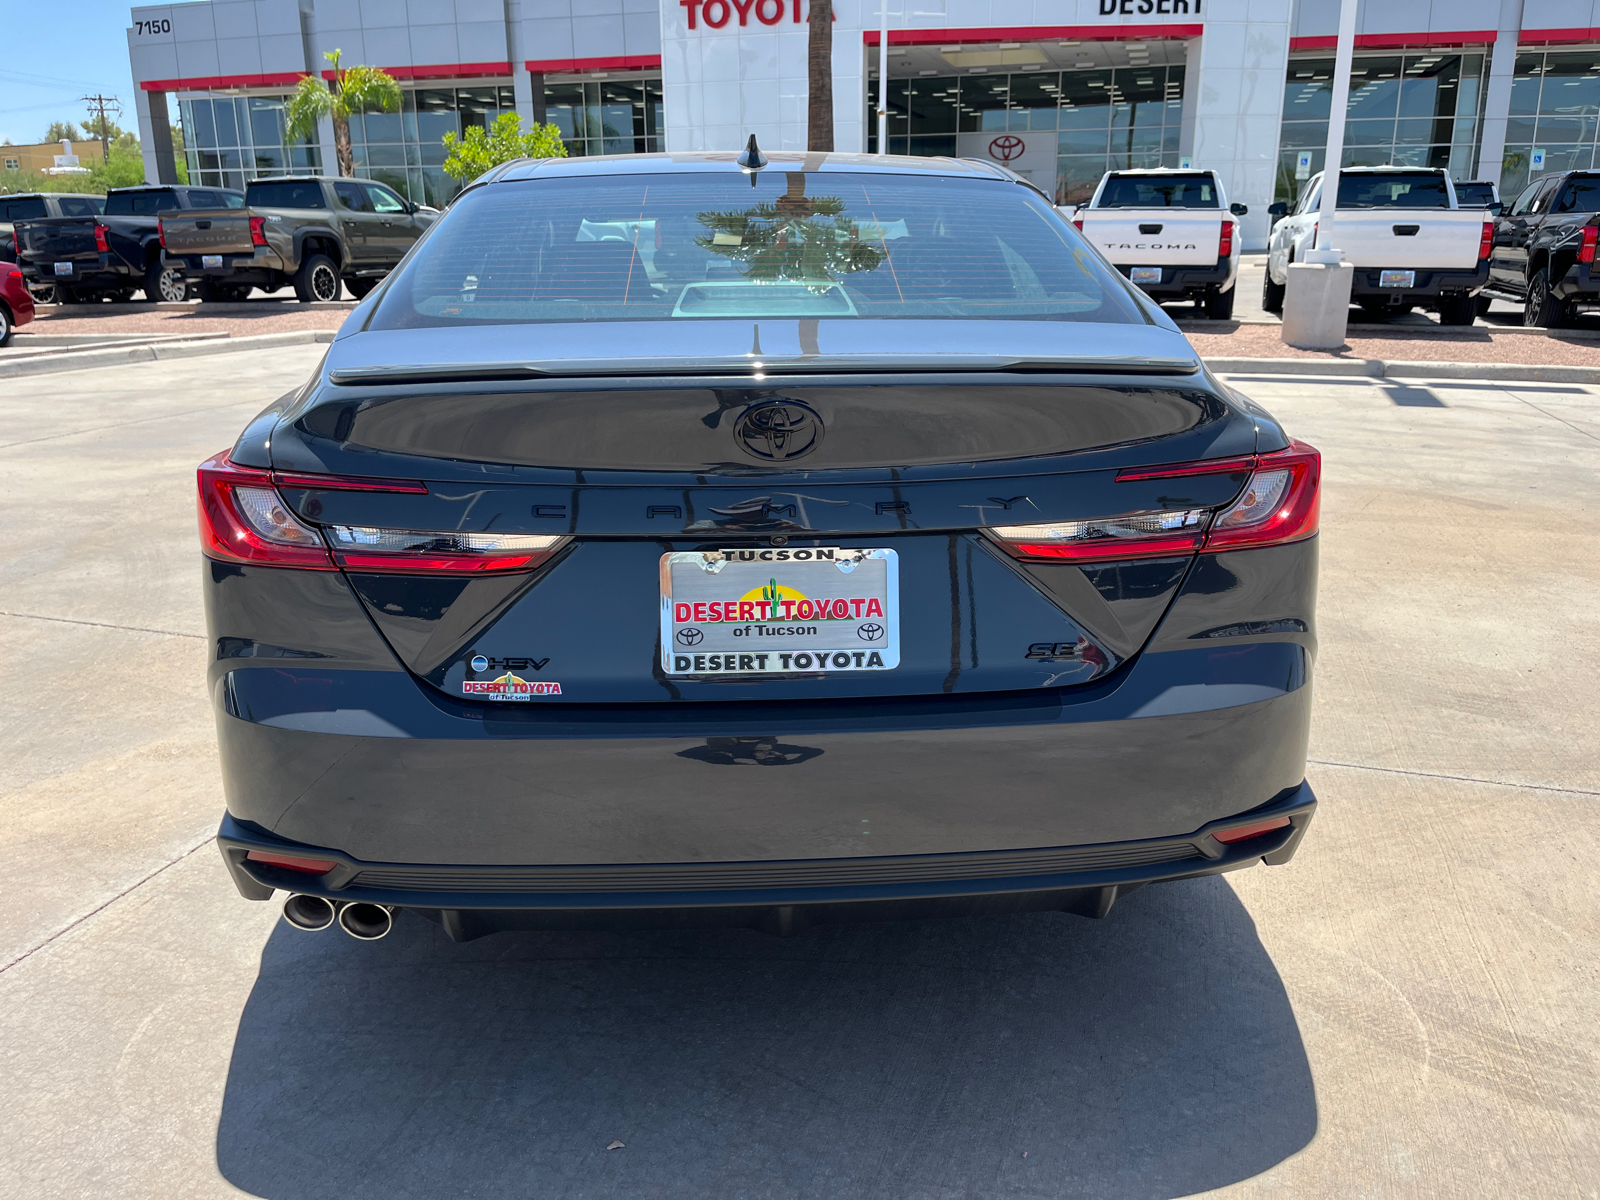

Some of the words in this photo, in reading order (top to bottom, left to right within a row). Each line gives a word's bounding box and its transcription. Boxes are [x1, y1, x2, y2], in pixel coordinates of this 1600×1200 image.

[135, 19, 171, 35] 7150
[531, 495, 1029, 520] CAMRY
[722, 549, 835, 562] TUCSON
[675, 600, 771, 623] DESERT
[779, 598, 884, 621] TOYOTA
[733, 625, 752, 637] of
[754, 625, 817, 637] Tucson
[1024, 642, 1078, 660] SE
[489, 657, 551, 671] HEV
[674, 653, 769, 672] DESERT
[779, 651, 885, 670] TOYOTA
[464, 682, 509, 693] DESERT
[513, 682, 561, 694] TOYOTA
[501, 693, 529, 701] Tucson
